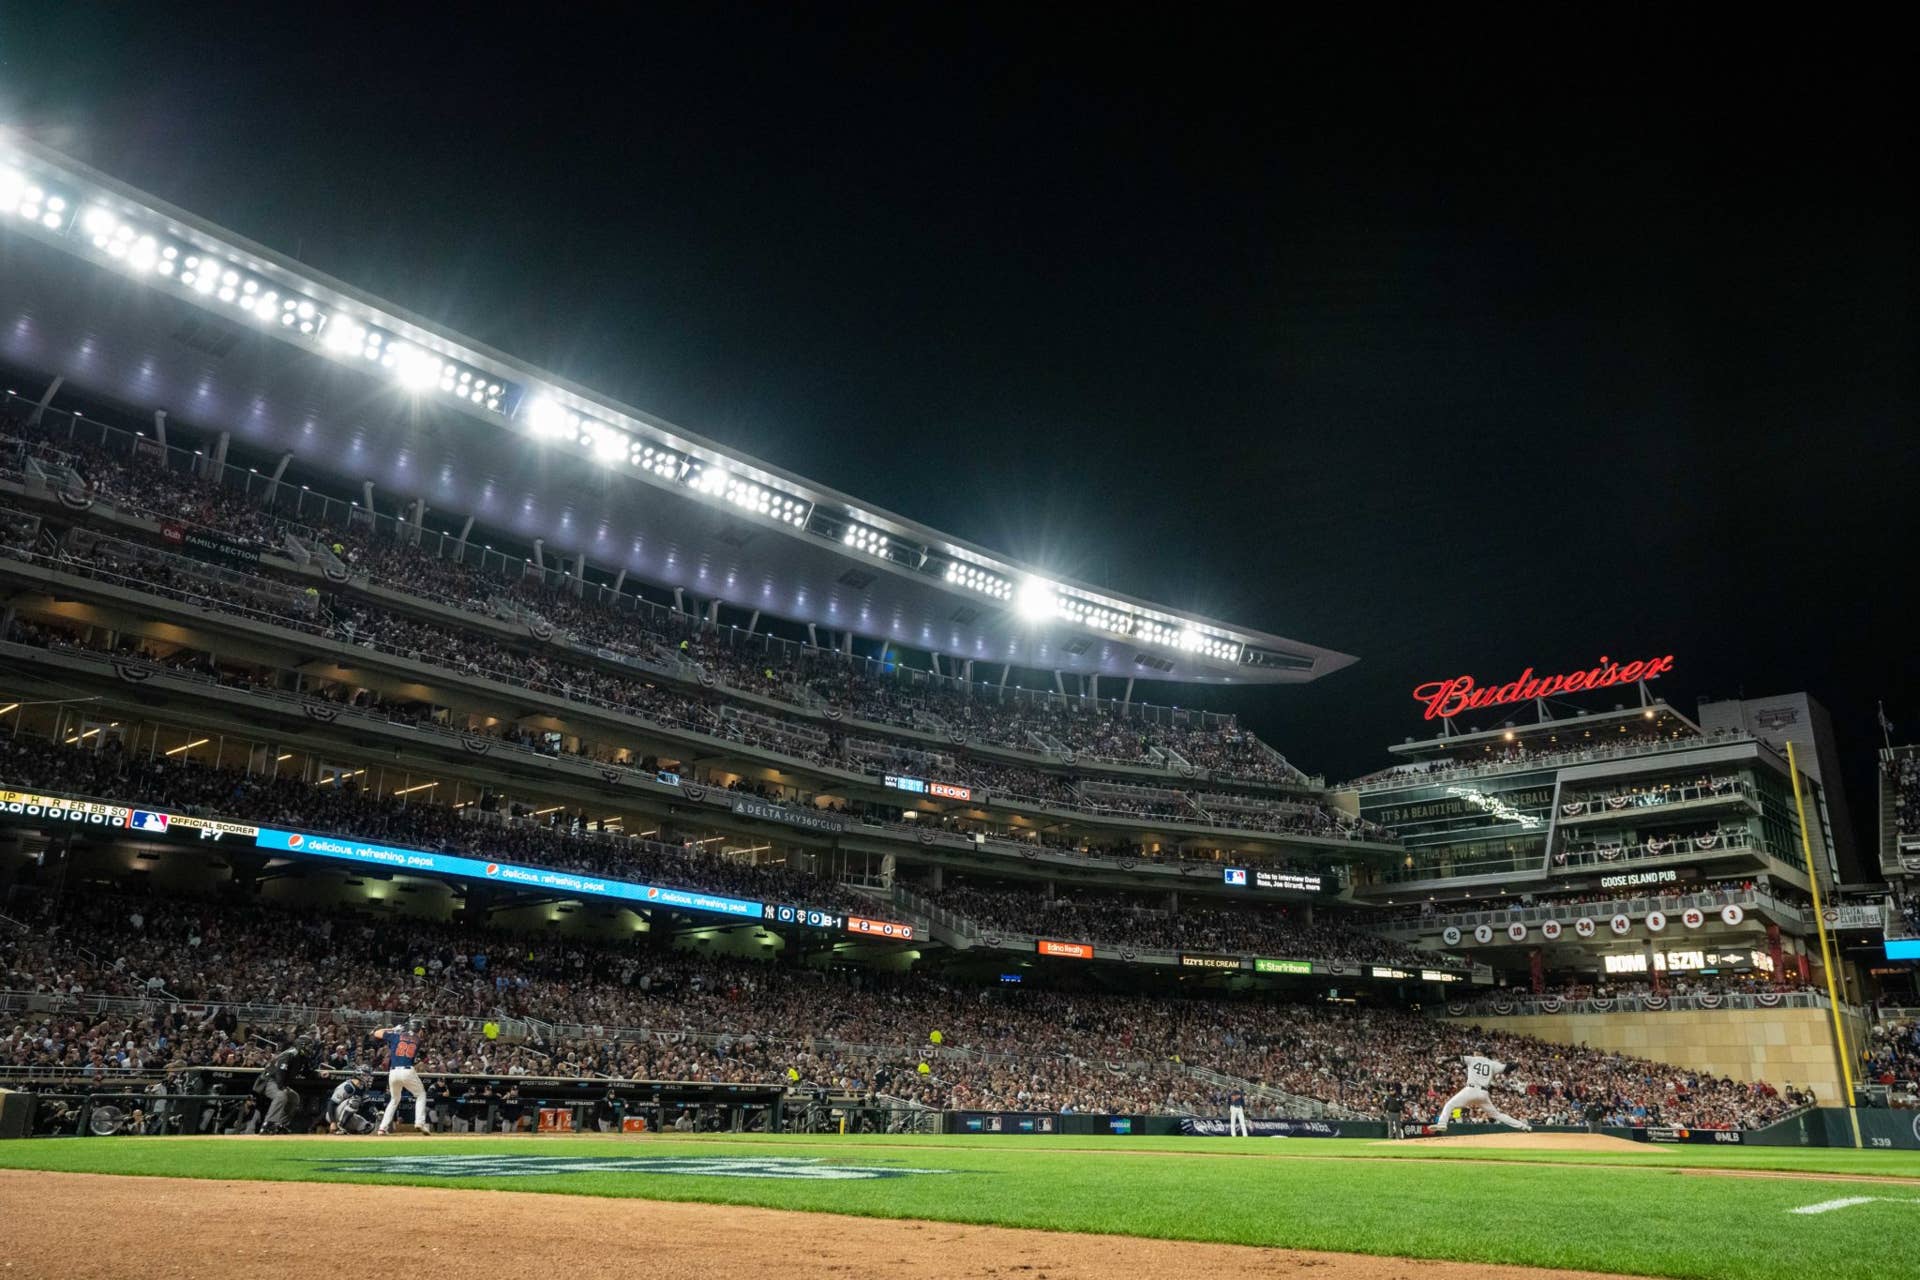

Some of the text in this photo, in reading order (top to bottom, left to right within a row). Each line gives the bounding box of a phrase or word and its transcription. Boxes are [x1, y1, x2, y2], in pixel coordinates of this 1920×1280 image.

[186, 535, 217, 549] FAMILY
[220, 544, 258, 561] SECTION
[1413, 655, 1674, 720] Budweiser
[4, 792, 127, 817] IP H R ER BB SO
[747, 804, 780, 819] DELTA
[1380, 810, 1400, 822] IT'S
[1402, 810, 1410, 820] A
[1411, 803, 1462, 818] BEAUTIFUL
[170, 816, 255, 834] OFFICIAL SCORER
[200, 828, 224, 840] F7
[1256, 872, 1270, 880] Cubs
[1278, 874, 1304, 882] interview
[1305, 876, 1320, 884] David
[1601, 870, 1676, 888] GOOSE ISLAND PUB
[1273, 880, 1283, 888] Joe
[782, 909, 791, 920] 0
[812, 913, 821, 924] 0
[1686, 914, 1699, 923] 29
[1729, 910, 1736, 919] 3
[1578, 922, 1591, 931] 34
[1615, 920, 1625, 929] 14
[1652, 917, 1659, 926] 6
[861, 920, 868, 931] 2
[884, 924, 892, 935] 0
[902, 927, 910, 937] 0
[1480, 930, 1486, 938] 7
[1512, 927, 1522, 936] 10
[1546, 925, 1557, 934] 28
[1446, 931, 1457, 940] 42
[1216, 960, 1240, 968] CREAM
[1668, 951, 1705, 970] SZN
[1474, 1063, 1490, 1076] 40
[1714, 1132, 1740, 1142] @MLB
[1872, 1138, 1892, 1146] 339
